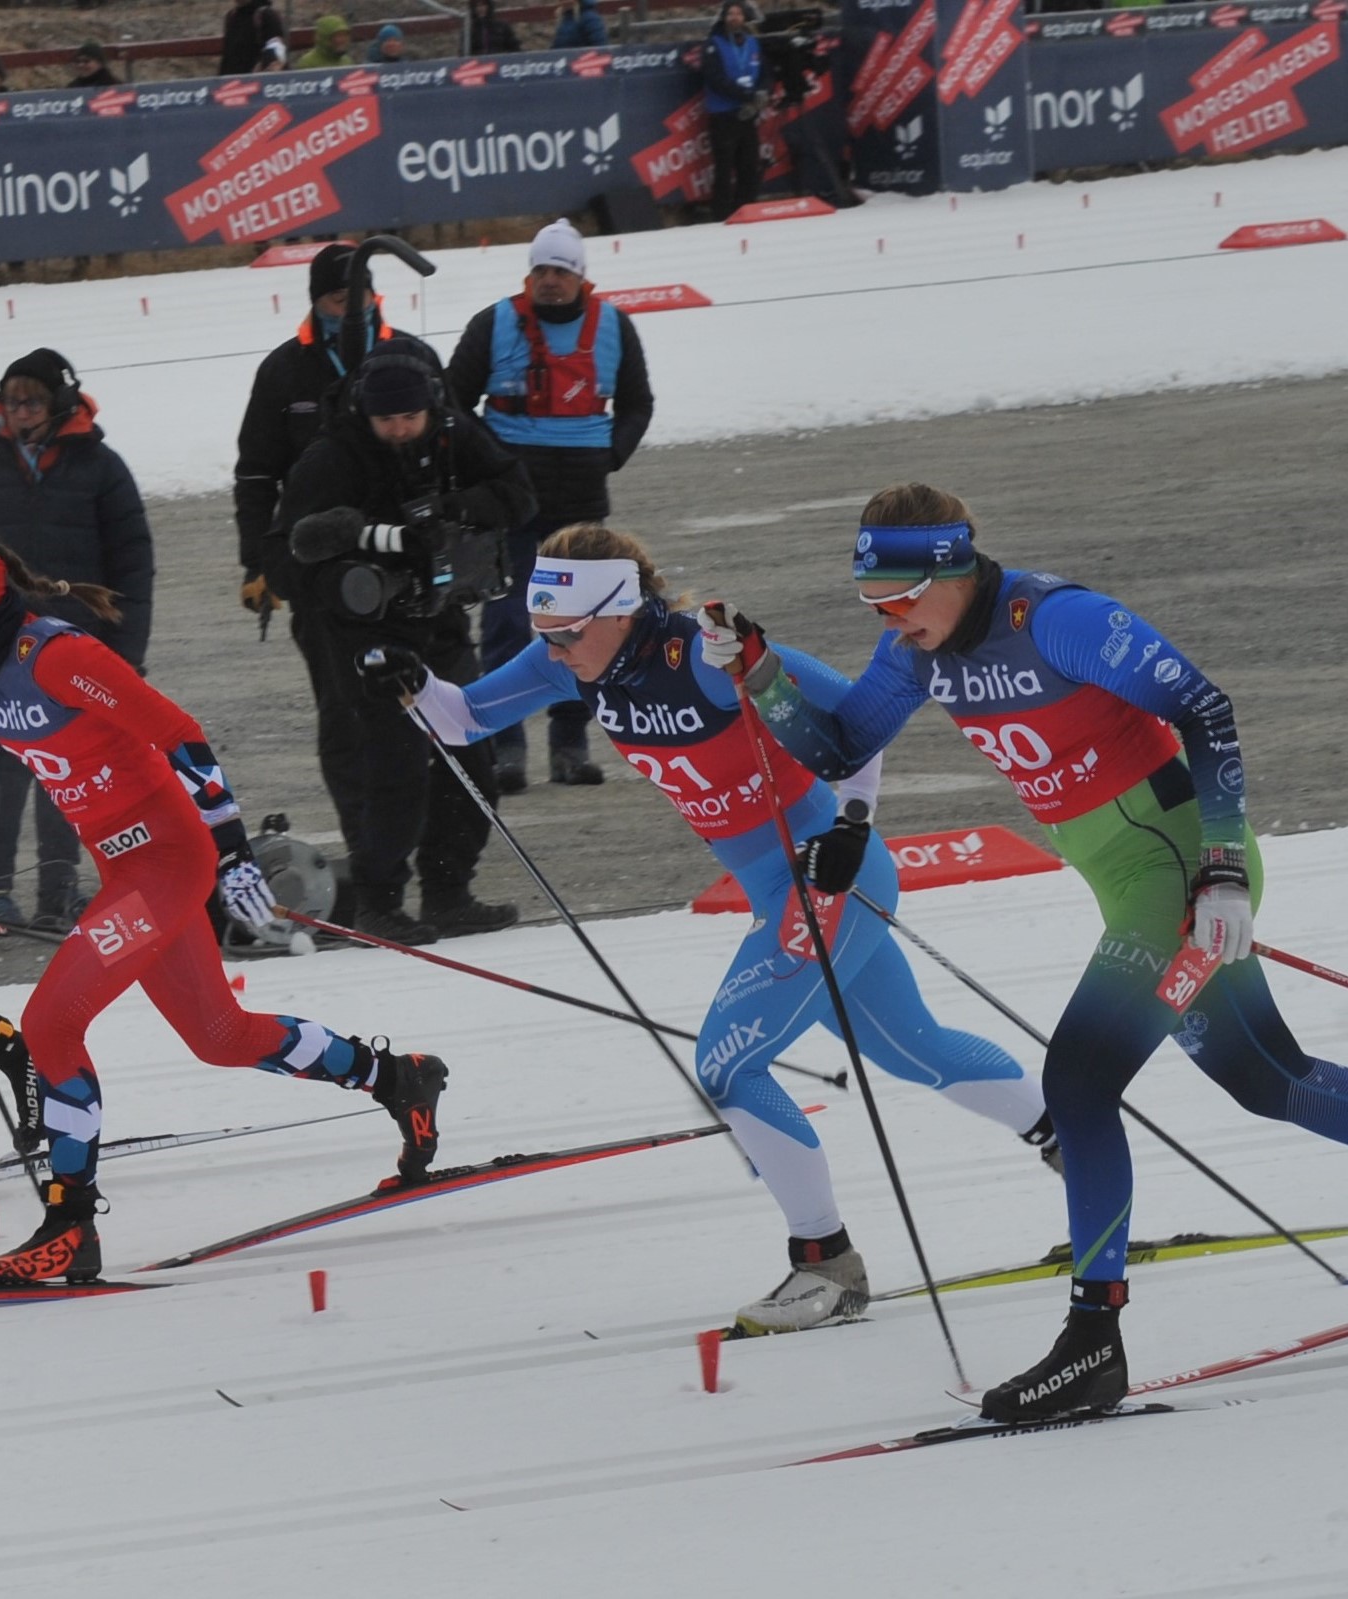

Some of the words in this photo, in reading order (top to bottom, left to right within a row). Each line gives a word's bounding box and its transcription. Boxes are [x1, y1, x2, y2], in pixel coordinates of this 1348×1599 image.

[380, 69, 433, 90] equinor
[500, 60, 552, 80] equinor
[613, 51, 667, 71] equinor
[137, 88, 194, 109] equinor
[264, 78, 322, 100] equinor
[1174, 33, 1331, 136] MORGENDAGENS
[12, 97, 70, 119] equinor
[1027, 82, 1103, 131] inor
[1212, 101, 1292, 152] HELTER
[182, 107, 370, 225] MORGENDAGENS
[398, 123, 576, 193] equinor
[228, 181, 323, 242] HELTER
[70, 674, 118, 709] SKILINE
[961, 663, 1044, 703] bilia
[629, 701, 705, 736] bilia
[961, 722, 1053, 772] 30
[627, 752, 713, 794] 21
[1010, 768, 1065, 799] inor
[46, 782, 88, 806] inor
[88, 918, 124, 957] 20
[1165, 970, 1197, 1007] 30
[1019, 1344, 1114, 1406] MADSHUS
